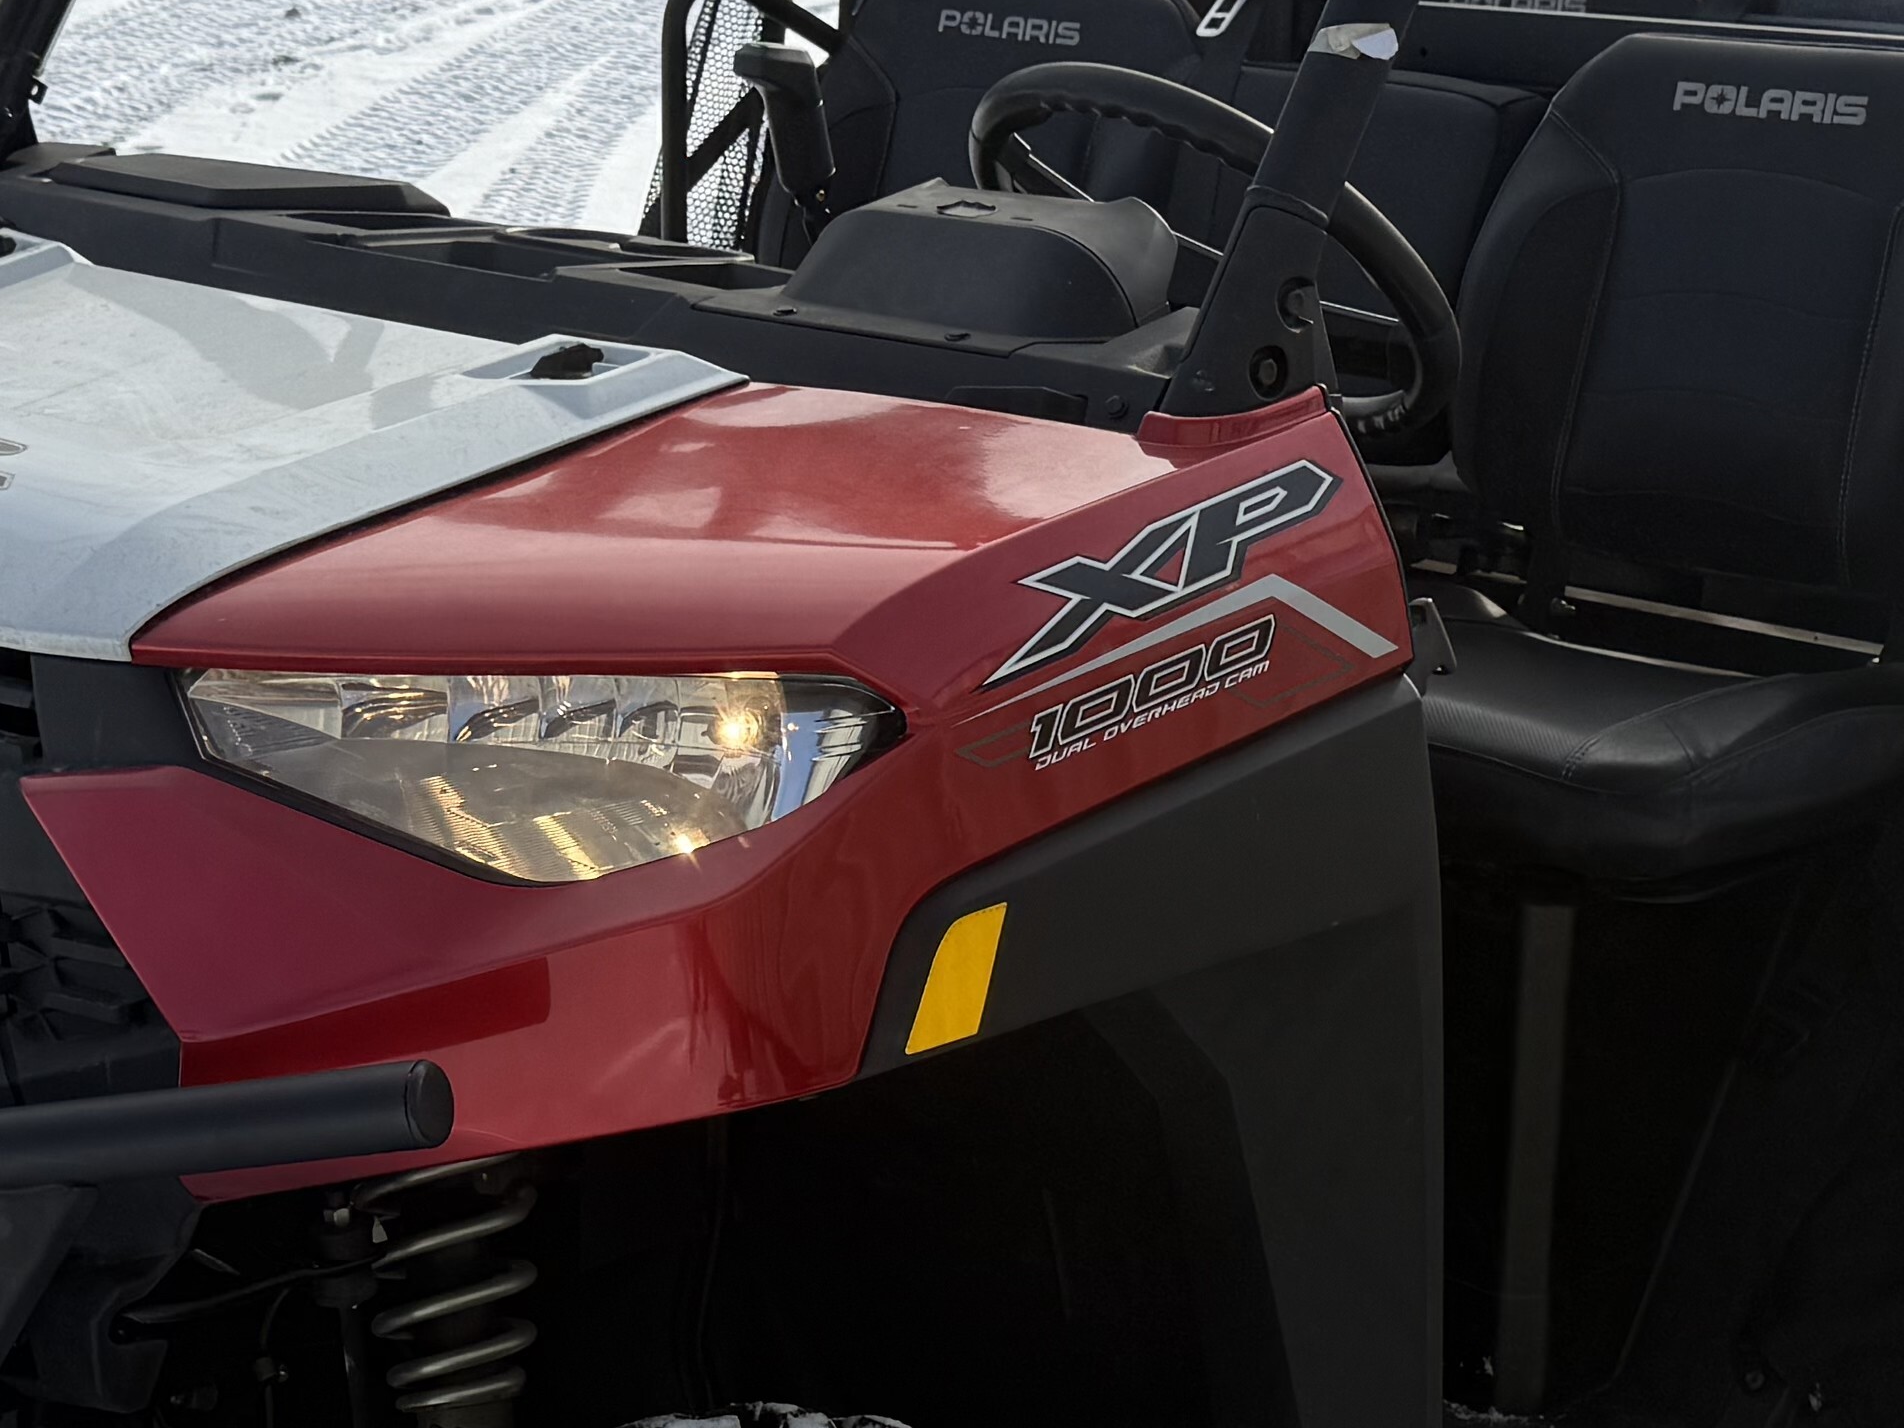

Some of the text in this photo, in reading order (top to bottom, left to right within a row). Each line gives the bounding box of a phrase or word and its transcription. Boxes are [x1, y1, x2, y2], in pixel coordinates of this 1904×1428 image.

[938, 9, 1081, 46] POLARIS
[1673, 81, 1868, 125] POLARIS
[973, 459, 1343, 693] XP
[1029, 613, 1276, 760] 1000
[1034, 659, 1270, 772] DUAL OVERHEAD CAM
